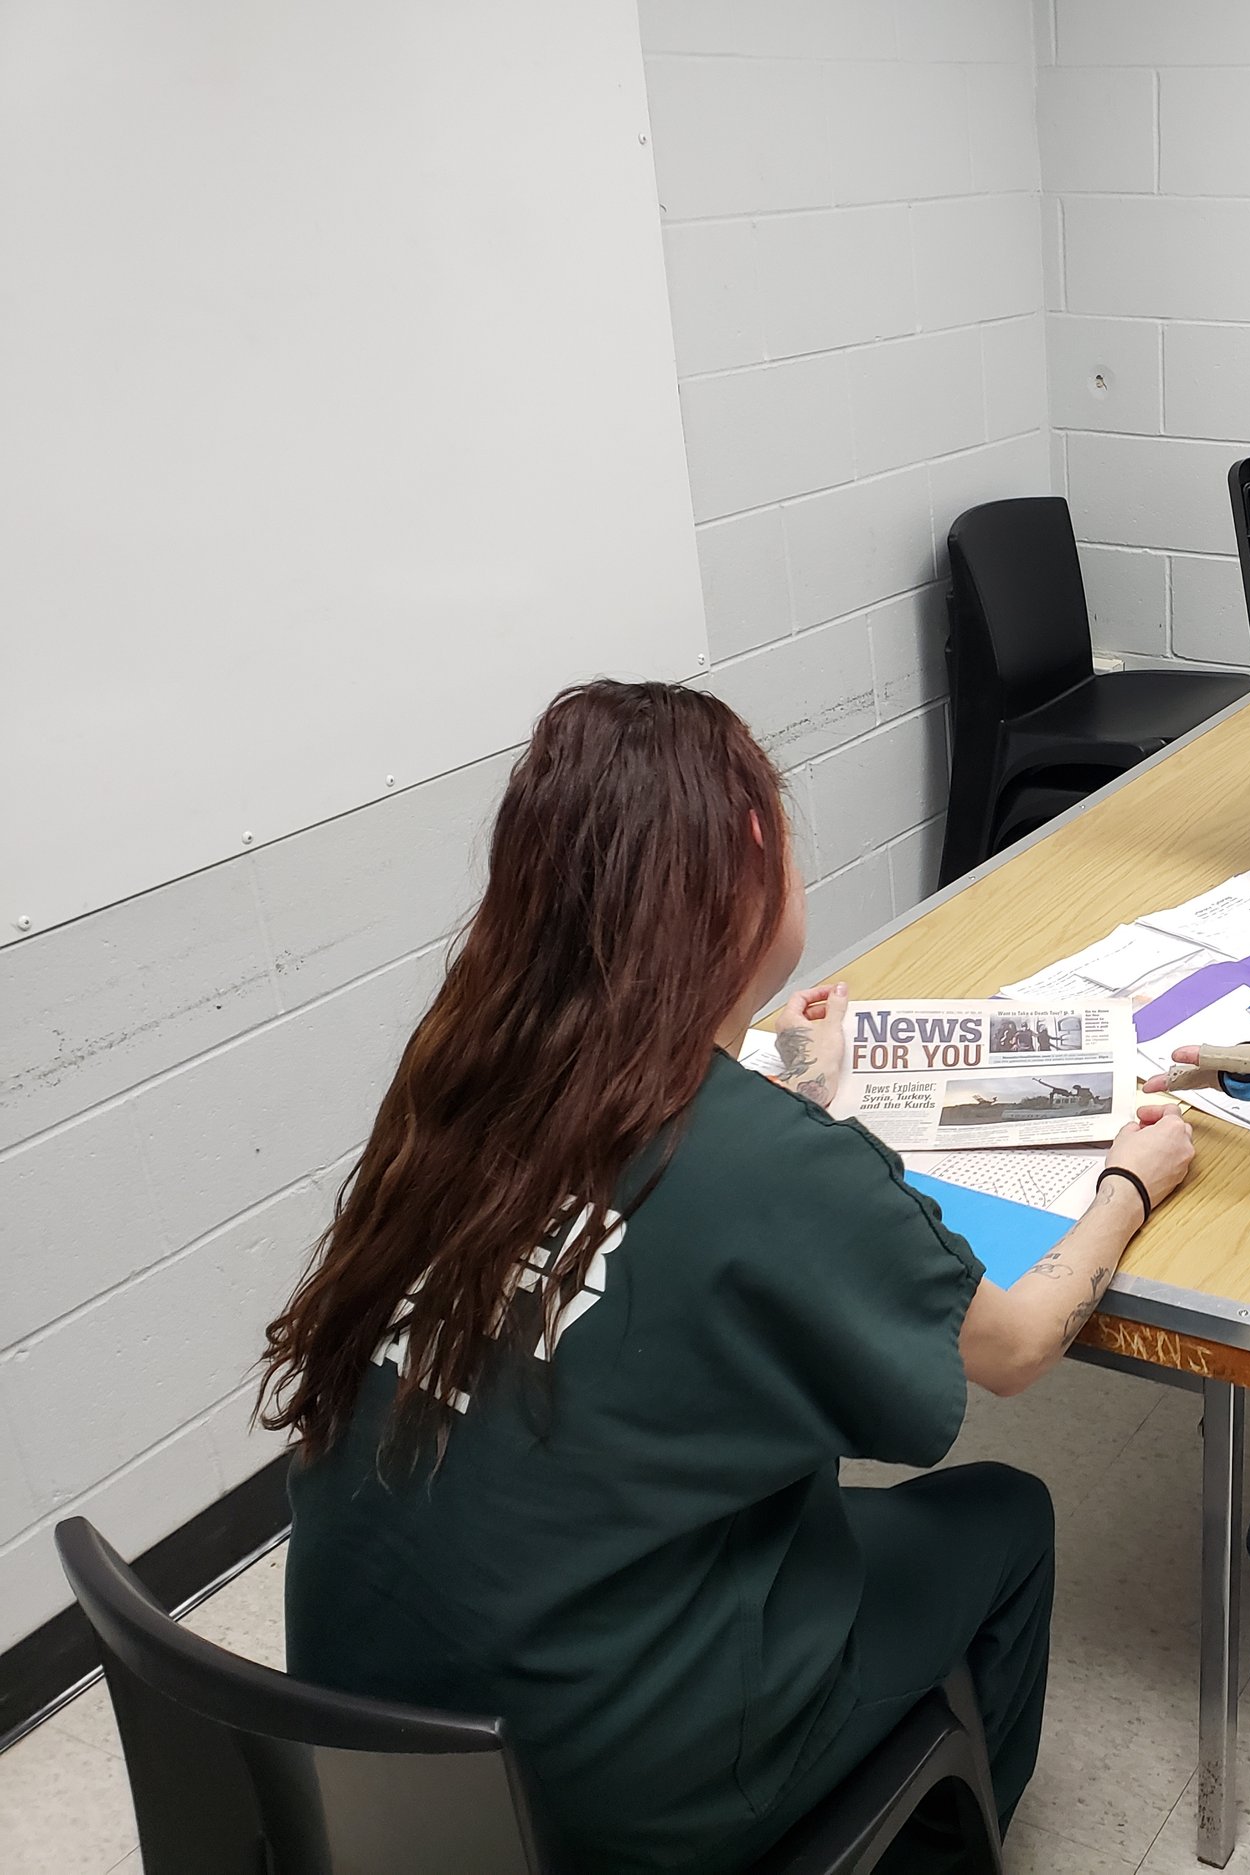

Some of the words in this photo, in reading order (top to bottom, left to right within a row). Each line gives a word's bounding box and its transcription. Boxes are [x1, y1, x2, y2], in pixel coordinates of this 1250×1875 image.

[853, 1011, 982, 1043] News
[852, 1044, 908, 1069] FOR
[922, 1044, 981, 1067] YOU
[864, 1083, 891, 1094] News
[892, 1081, 937, 1094] Explainer:
[862, 1094, 893, 1103] Syria,
[896, 1093, 932, 1102] Turkey,
[859, 1102, 881, 1110] and
[883, 1101, 901, 1109] the
[904, 1100, 936, 1109] Kurds
